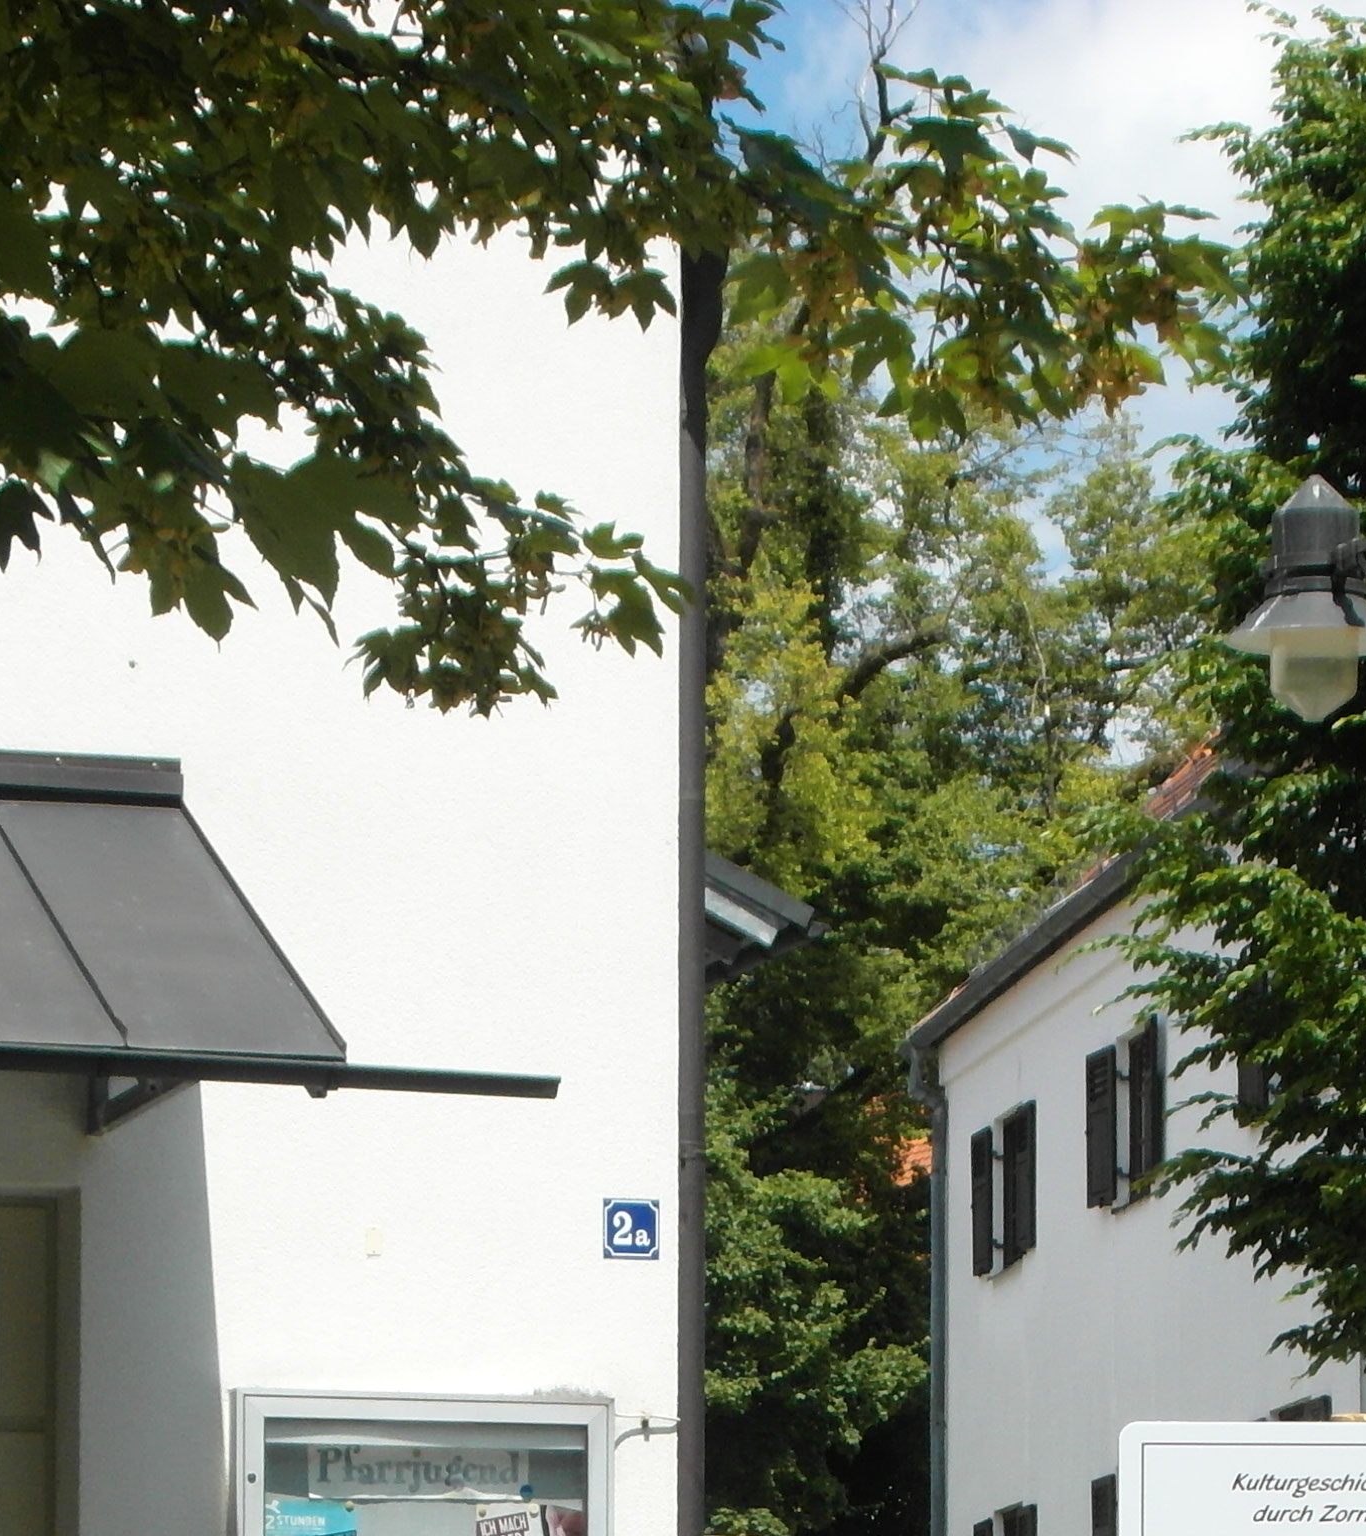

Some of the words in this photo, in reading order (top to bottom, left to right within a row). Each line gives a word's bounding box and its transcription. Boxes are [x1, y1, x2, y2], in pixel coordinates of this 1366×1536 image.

[613, 1211, 651, 1247] 2a
[316, 1445, 520, 1494] Pfarrjugend
[276, 1514, 327, 1527] STUNDEN
[479, 1519, 498, 1536] ICH
[498, 1513, 528, 1534] MACH
[1252, 1504, 1314, 1523] durch
